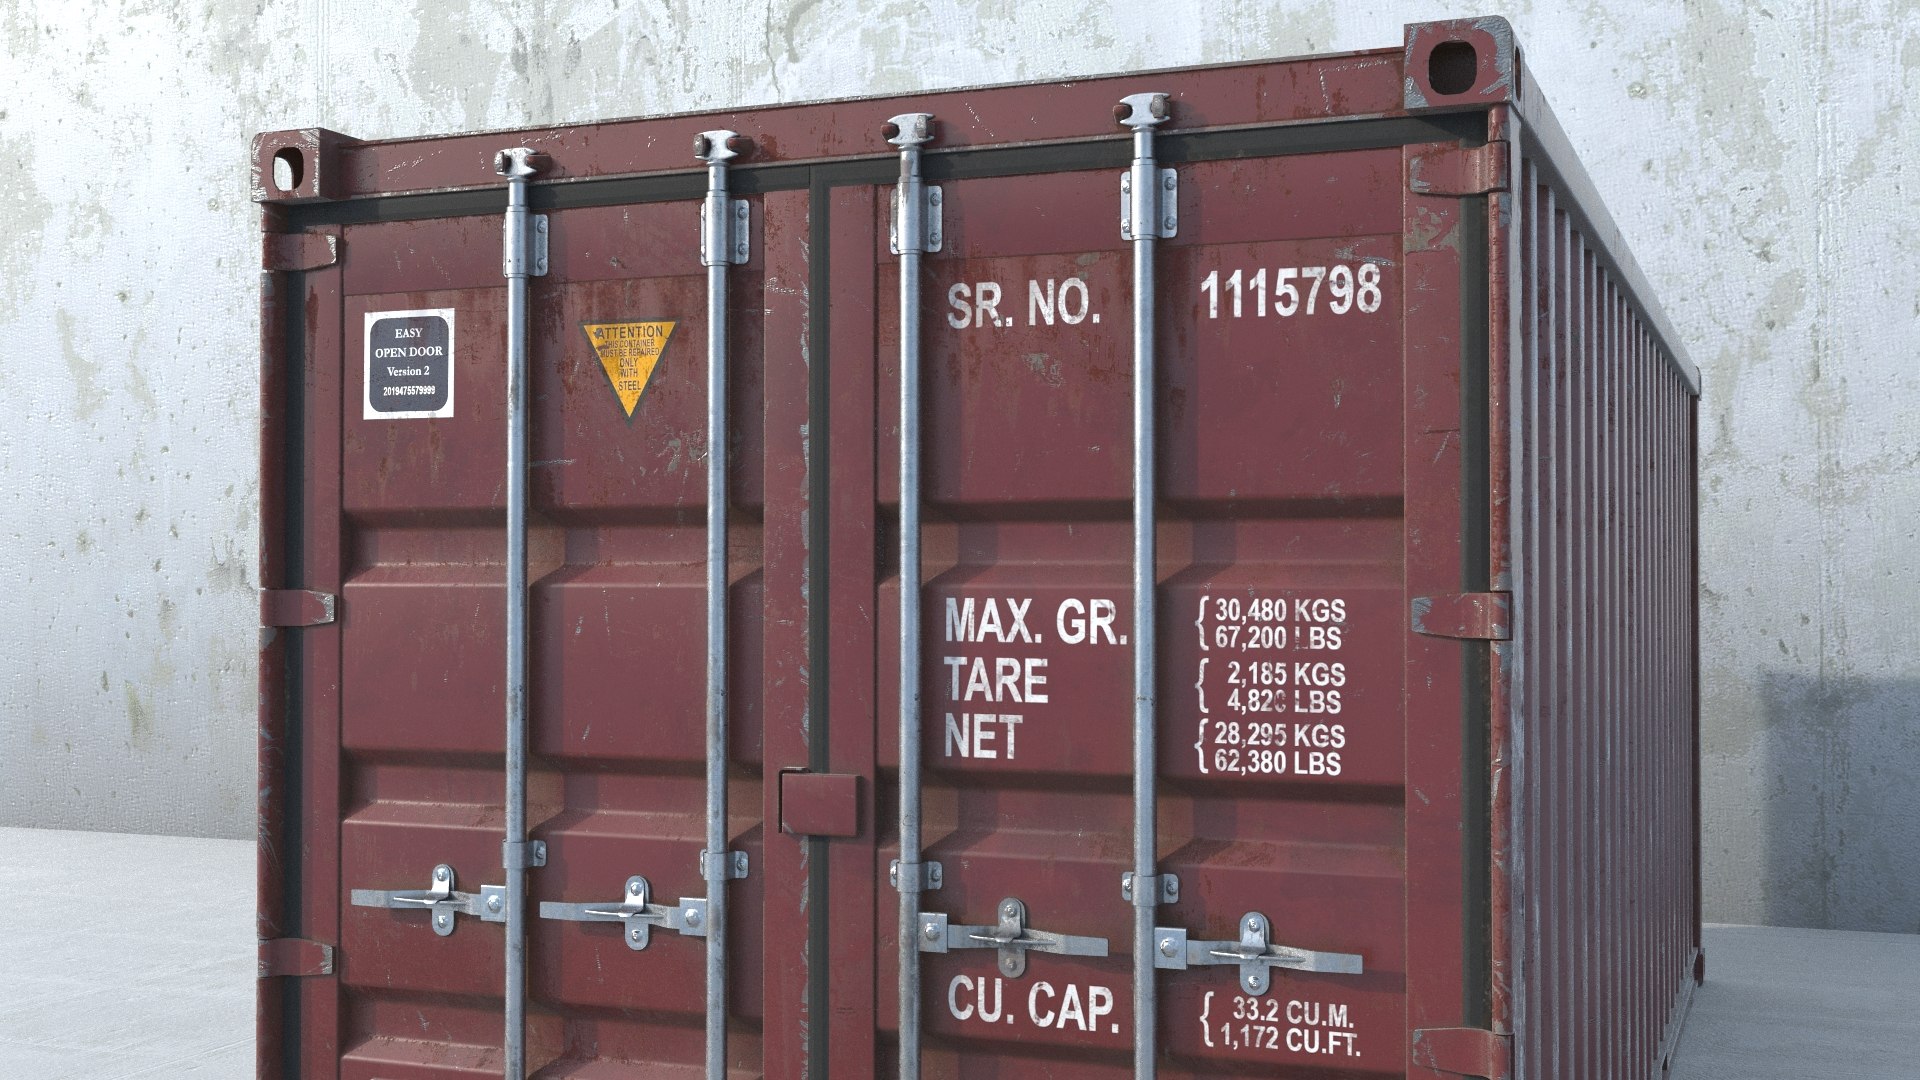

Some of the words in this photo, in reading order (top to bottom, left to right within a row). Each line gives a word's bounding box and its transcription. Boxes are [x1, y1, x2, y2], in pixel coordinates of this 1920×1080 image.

[948, 282, 1013, 330] SR.
[1028, 278, 1100, 327] NO.
[1200, 263, 1382, 319] 1115798
[394, 328, 423, 338] EASY
[595, 326, 663, 339] ATTENTION
[605, 340, 619, 348] THIS
[619, 339, 655, 348] CONTAINER
[375, 347, 406, 358] OPEN
[409, 346, 443, 357] DOOR
[601, 349, 618, 357] MUST
[620, 348, 628, 356] BE
[629, 348, 660, 356] REPAIRED
[620, 358, 639, 368] ONLY
[386, 366, 422, 376] Version
[424, 366, 430, 376] 2
[619, 368, 638, 378] WITH
[618, 380, 641, 391] STEEL
[945, 597, 1042, 644] MAX.
[1056, 598, 1128, 645] GR.
[1215, 598, 1288, 625] 30,480
[1294, 598, 1346, 622] KGS
[1215, 625, 1288, 652] 67,200
[1294, 626, 1342, 650] LBS
[944, 656, 1048, 703] TARE
[1227, 661, 1288, 688] 2,185
[1294, 662, 1346, 687] KGS
[1227, 688, 1287, 715] 4,820
[1294, 690, 1342, 714] LBS
[945, 713, 1024, 760] NET
[1214, 721, 1287, 748] 28,295
[1294, 723, 1346, 748] KGS
[1214, 749, 1287, 776] 62,380
[1294, 751, 1342, 776] LBS
[948, 974, 1014, 1024] CU.
[1028, 981, 1119, 1034] CAP.
[1232, 996, 1279, 1022] 33.2
[1286, 1000, 1354, 1028] CU.M.
[1220, 1022, 1279, 1050] 1,172
[1286, 1027, 1361, 1056] CU.FT.
